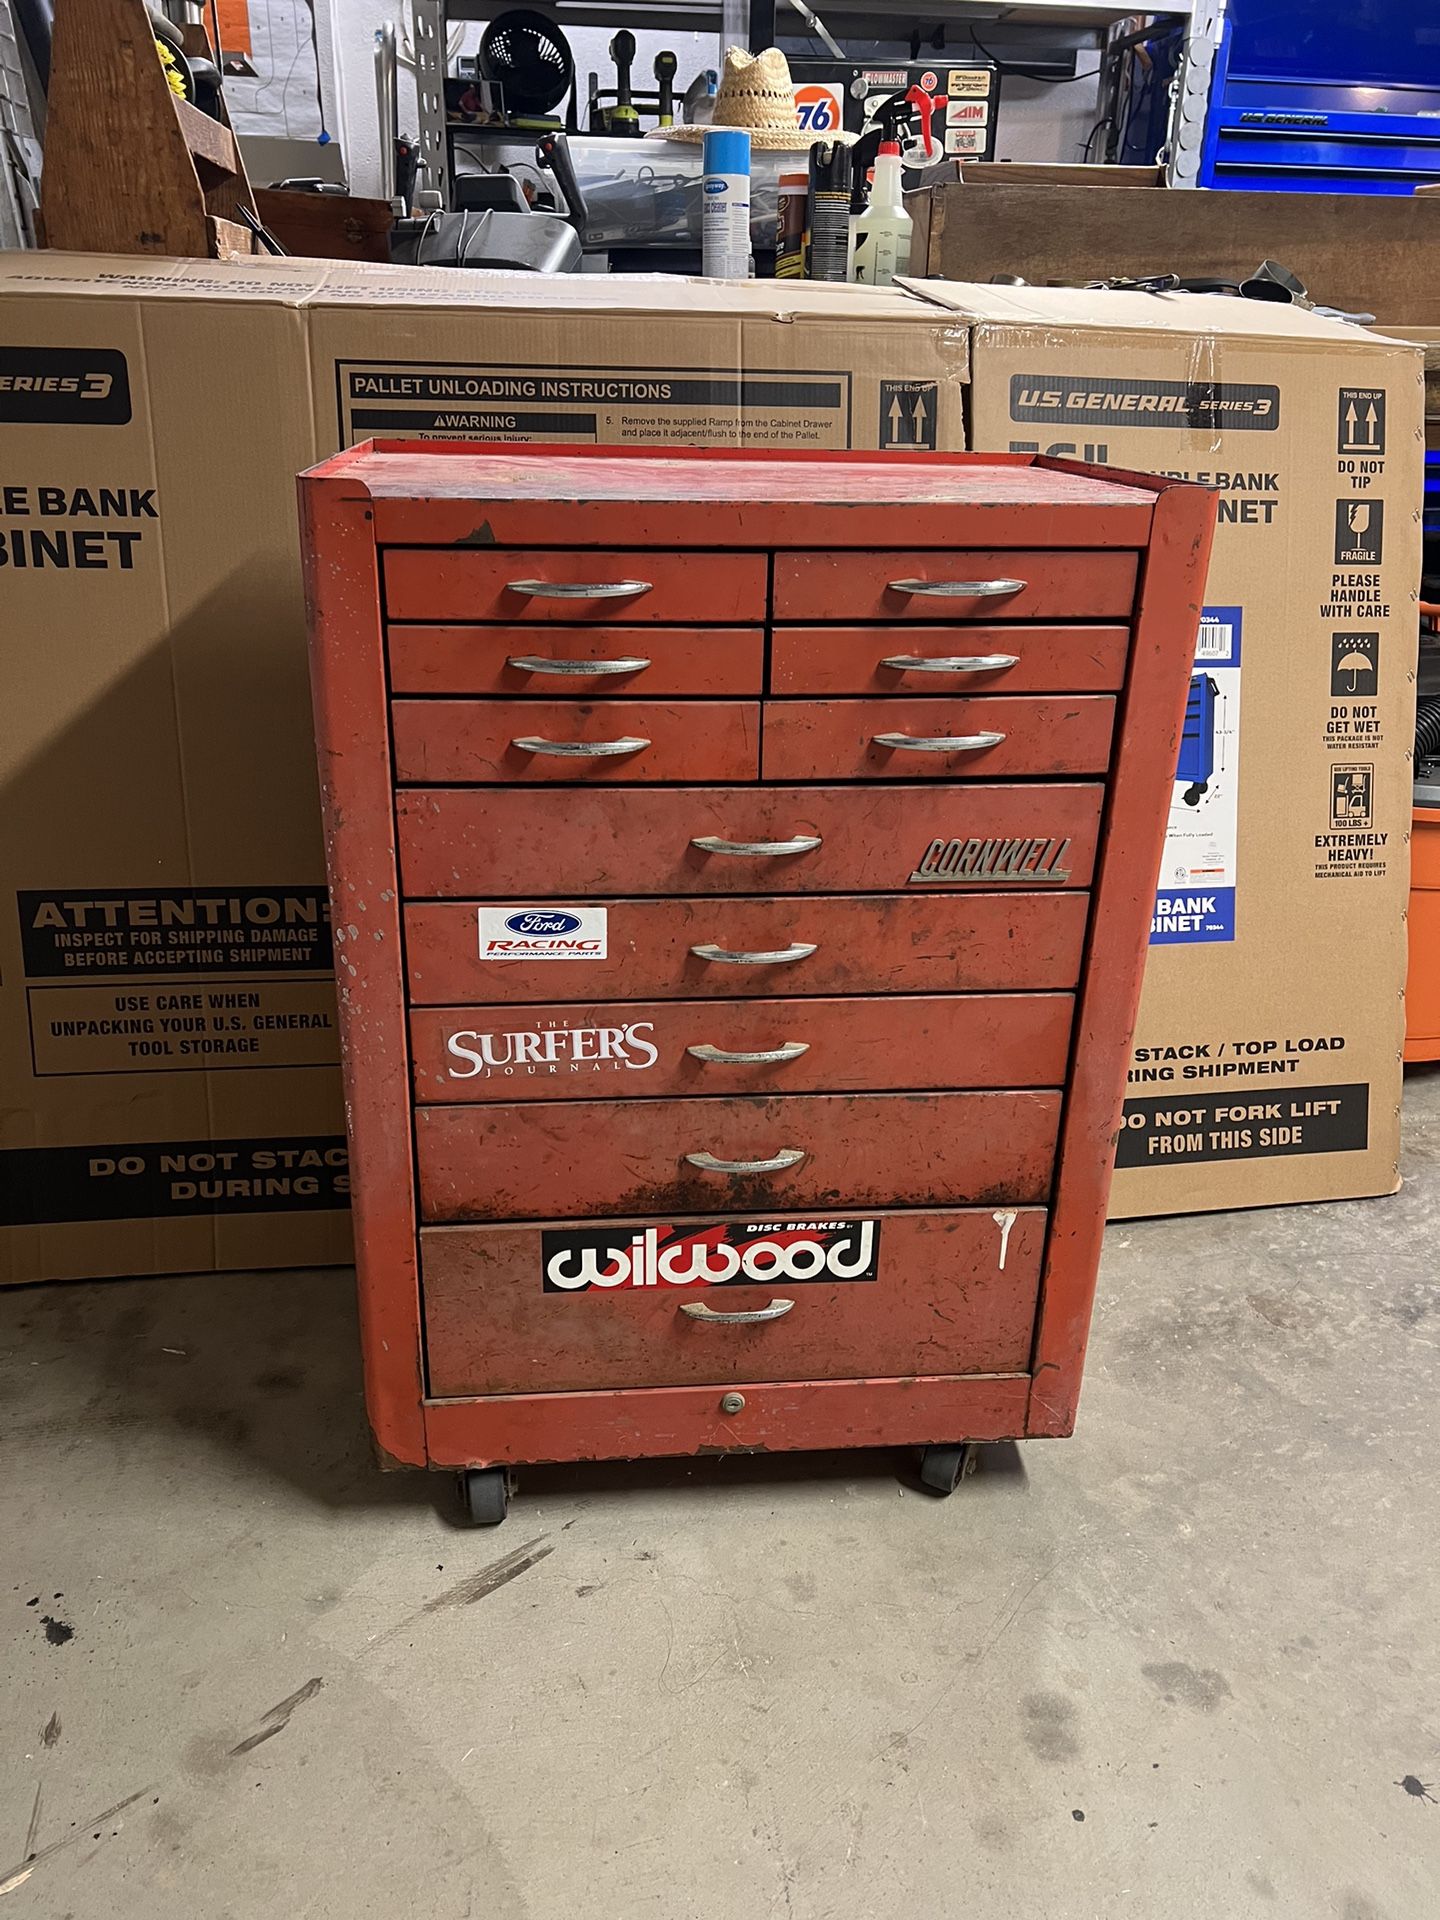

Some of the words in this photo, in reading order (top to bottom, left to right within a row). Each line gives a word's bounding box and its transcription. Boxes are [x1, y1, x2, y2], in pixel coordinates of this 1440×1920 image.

[924, 77, 934, 86] 76
[797, 101, 832, 131] 76
[951, 106, 984, 119] AIM
[99, 273, 219, 285] WARNING:
[0, 374, 80, 392] ERIES
[80, 373, 114, 399] 3
[355, 377, 424, 394] PALLET
[429, 380, 536, 397] UNLOADING
[541, 382, 671, 400] INSTRUCTIONS
[885, 384, 903, 392] THIS
[904, 384, 920, 392] END
[1017, 389, 1063, 408] U.S.
[1065, 392, 1191, 413] GENERAL
[1198, 400, 1254, 411] SERIES
[1253, 398, 1272, 415] 3
[1373, 392, 1382, 400] UP
[446, 414, 516, 429] WARNING
[606, 416, 614, 426] 5.
[622, 416, 655, 426] Remove
[657, 417, 671, 426] the
[673, 417, 707, 428] supplied
[709, 418, 733, 428] Ramp
[735, 418, 754, 427] from
[755, 419, 769, 428] the
[770, 419, 802, 428] Cabinet
[803, 420, 833, 429] Drawer
[622, 429, 638, 437] and
[639, 429, 662, 439] place
[663, 429, 669, 437] it
[670, 429, 727, 439] adjacent/flush
[729, 431, 737, 439] to
[739, 430, 752, 439] the
[754, 430, 770, 439] end
[771, 431, 780, 439] of
[781, 431, 795, 439] the
[796, 431, 820, 440] Pallet.
[1338, 460, 1355, 473] DO
[1360, 461, 1385, 473] NOT
[1215, 472, 1280, 491] BANK
[1350, 476, 1371, 488] TIP
[38, 486, 160, 518] BANK
[1217, 499, 1278, 523] NET
[1340, 551, 1376, 561] FRAGILE
[1332, 574, 1380, 587] PLEASE
[1330, 589, 1381, 602] HANDLE
[1320, 604, 1352, 618] WITH
[1356, 604, 1390, 618] CARE
[1330, 706, 1347, 719] DO
[1352, 706, 1378, 719] NOT
[1326, 721, 1350, 734] GET
[1354, 720, 1381, 733] WET
[1348, 819, 1362, 827] LBS
[1314, 833, 1388, 847] EXTREMELY
[918, 837, 1073, 879] CORNWELL
[1328, 848, 1374, 861] HEAVY!
[32, 897, 331, 929] ATTENTION:
[1157, 896, 1217, 915] BANK
[519, 913, 567, 932] Ford
[54, 932, 124, 948] INSPECT
[130, 931, 162, 946] FOR
[168, 929, 245, 945] SHIPPING
[251, 928, 318, 944] DAMAGE
[486, 939, 602, 951] RACING
[64, 952, 128, 968] BEFORE
[133, 950, 224, 966] ACCEPTING
[230, 948, 312, 964] SHIPMENT
[115, 996, 149, 1012] USE
[156, 995, 203, 1010] CARE
[208, 993, 260, 1009] WHEN
[51, 1019, 154, 1037] UNPACKING
[160, 1017, 206, 1034] YOUR
[212, 1016, 247, 1031] U.S.
[253, 1013, 332, 1030] GENERAL
[535, 1020, 569, 1029] THE
[128, 1041, 174, 1057] TOOL
[180, 1037, 259, 1054] STORAGE
[447, 1022, 659, 1079] SURFER'S
[1134, 1044, 1211, 1062] STACK
[1232, 1040, 1277, 1056] TOP
[1285, 1036, 1345, 1053] LOAD
[485, 1061, 621, 1079] JOURNAL
[1182, 1059, 1299, 1080] SHIPMENT
[1155, 1109, 1207, 1128] NOT
[1215, 1103, 1281, 1123] FORK
[1290, 1100, 1341, 1118] LIFT
[1148, 1133, 1203, 1155] FROM
[1209, 1129, 1252, 1150] THIS
[1260, 1126, 1303, 1146] SIDE
[89, 1155, 145, 1177] DO
[160, 1152, 238, 1174] NOT
[251, 1149, 349, 1170] STAC
[171, 1176, 320, 1200] DURING
[746, 1223, 782, 1233] DISC
[786, 1221, 846, 1232] BRAKES
[546, 1220, 874, 1289] wilwood
